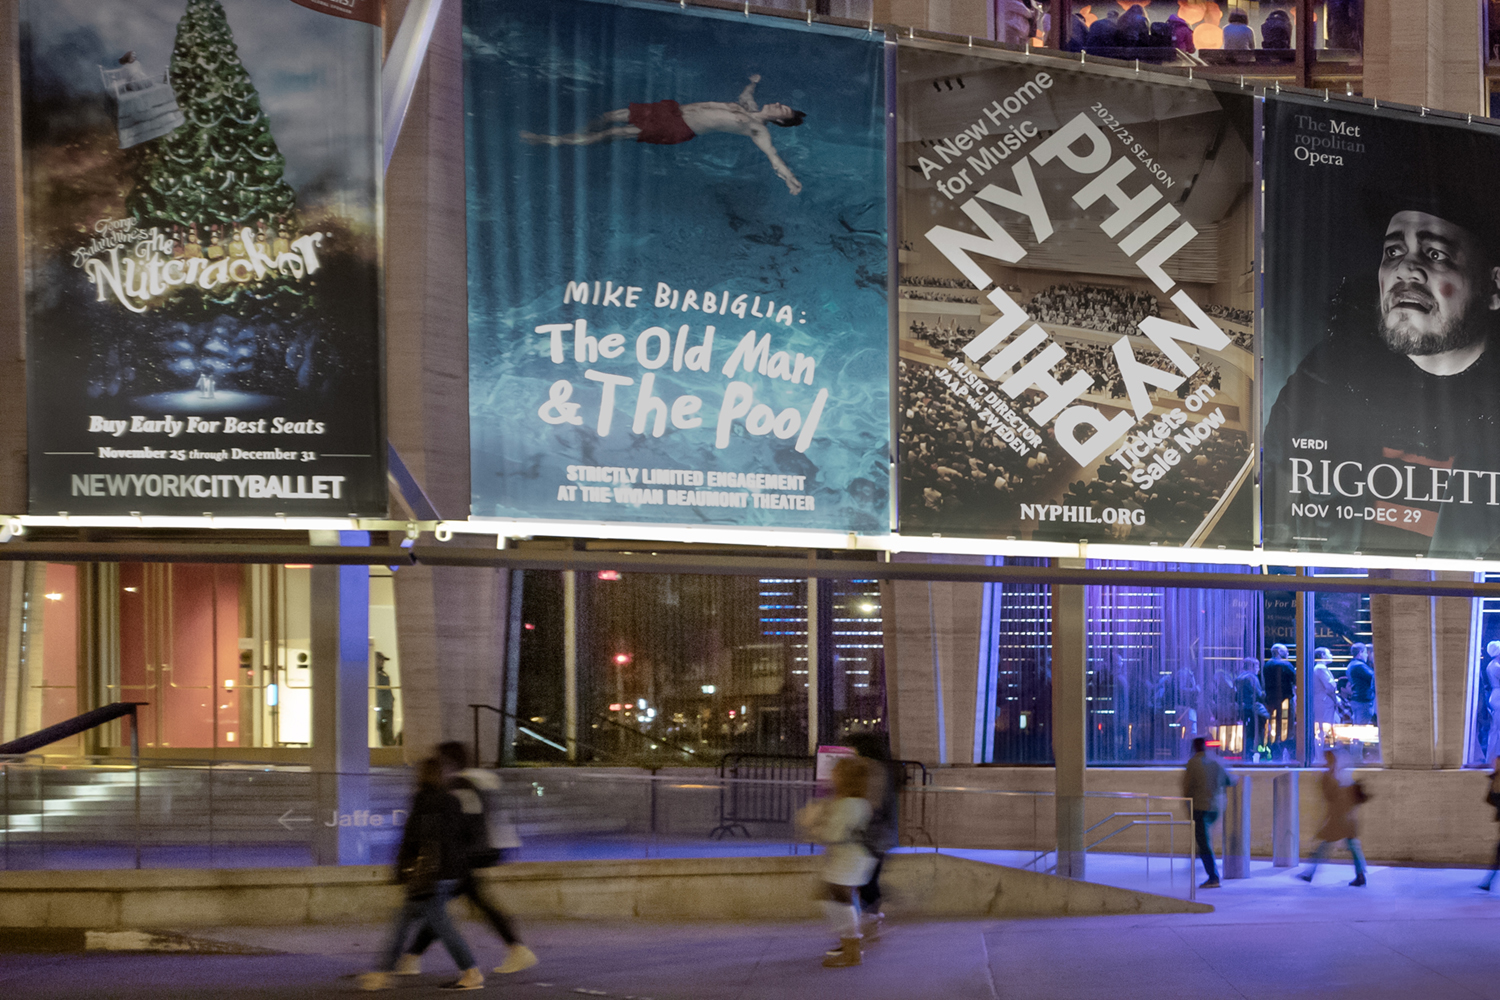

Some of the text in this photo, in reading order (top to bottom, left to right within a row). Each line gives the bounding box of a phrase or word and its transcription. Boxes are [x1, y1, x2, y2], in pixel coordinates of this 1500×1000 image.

[917, 71, 1054, 181] A New Home
[1294, 114, 1360, 137] The Met
[1295, 134, 1365, 153] ropolitan
[936, 120, 1038, 200] for Music
[1090, 101, 1176, 189] 2022/23 SEASON
[1294, 146, 1344, 166] Opera
[924, 111, 1199, 294] NY PHIL
[94, 217, 138, 235] George
[85, 226, 323, 313] Nutcracker
[563, 280, 807, 326] MIKE BIRBIGLIA:
[534, 318, 816, 386] The Old Man
[961, 286, 1232, 468] NY PHIL
[537, 368, 829, 454] & The Pool
[935, 368, 969, 397] JAAP
[977, 407, 1031, 457] ZWEDEN
[947, 356, 1043, 449] MUSIC DIRECTOR
[88, 415, 326, 437] Buy Early For Best Seats
[1109, 384, 1216, 470] Tickets on
[1292, 438, 1328, 450] VERDI
[98, 446, 318, 462] November 25 through December 31
[1131, 407, 1226, 490] Sale Now
[71, 474, 346, 499] NEWYORKCITYBALLET
[566, 465, 807, 491] STRICTLY LIMITED ENGAGEMENT
[557, 485, 816, 511] AT THE VIVIAN BEAUMONT THEATER
[1020, 503, 1146, 526] NYPHIL.ORG
[1291, 503, 1329, 518] NOV
[1403, 509, 1422, 523] 29
[324, 809, 384, 827] Jaffe
